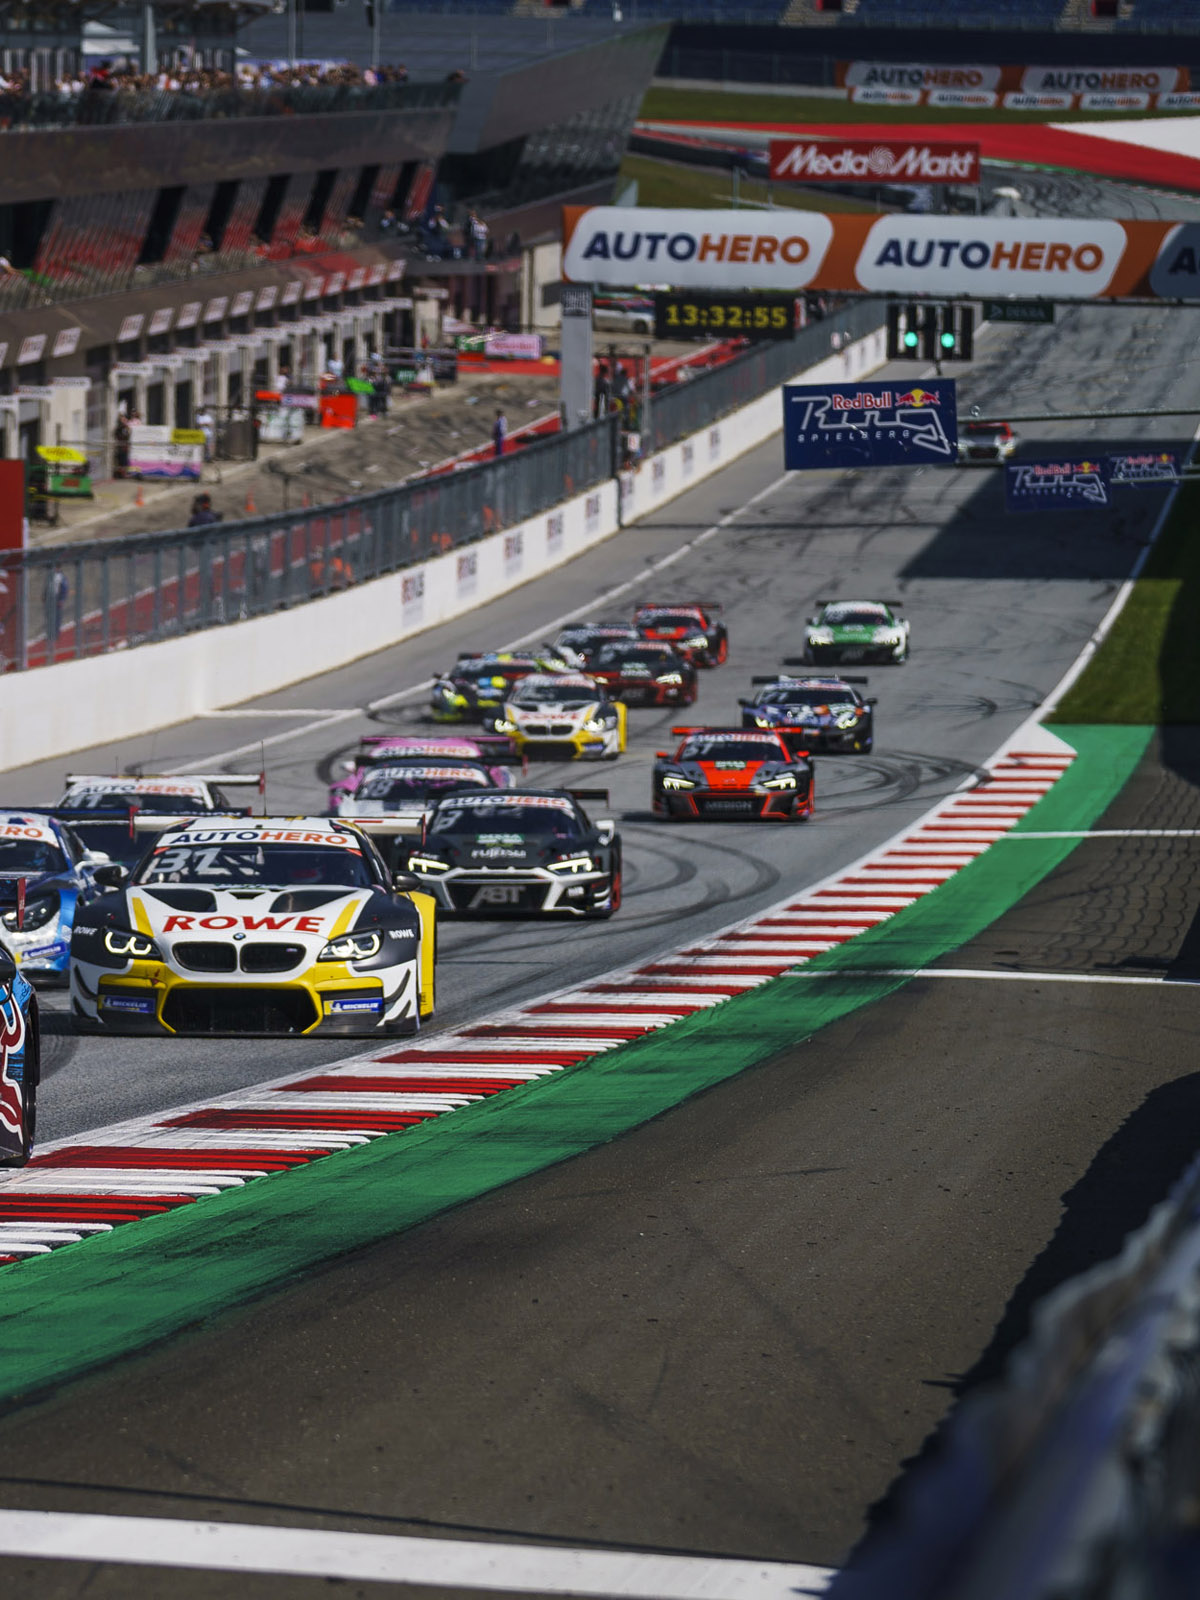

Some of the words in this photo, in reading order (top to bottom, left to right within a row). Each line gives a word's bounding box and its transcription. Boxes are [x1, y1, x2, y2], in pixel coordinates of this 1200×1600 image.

[865, 67, 984, 87] AUTOHERO
[1041, 69, 1160, 89] AUTOHERO
[776, 144, 869, 176] Media
[889, 146, 975, 178] Markt
[582, 231, 809, 265] AUTOHERO
[874, 238, 1104, 272] AUTOHERO
[665, 304, 787, 329] 13:32:55
[832, 392, 862, 410] Red
[863, 391, 892, 409] Bull
[797, 429, 910, 443] SPIELBERG
[378, 767, 477, 779] AUTOHERO
[80, 784, 196, 795] AUTOHERO
[447, 795, 567, 808] AUTOHERO
[170, 831, 348, 845] AUTOHERO
[153, 847, 233, 876] 31
[468, 885, 526, 908] ABT
[73, 925, 98, 936] ROWE
[162, 915, 326, 933] ROWE
[389, 929, 415, 940] ROWE
[342, 1002, 380, 1010] MICHELIN
